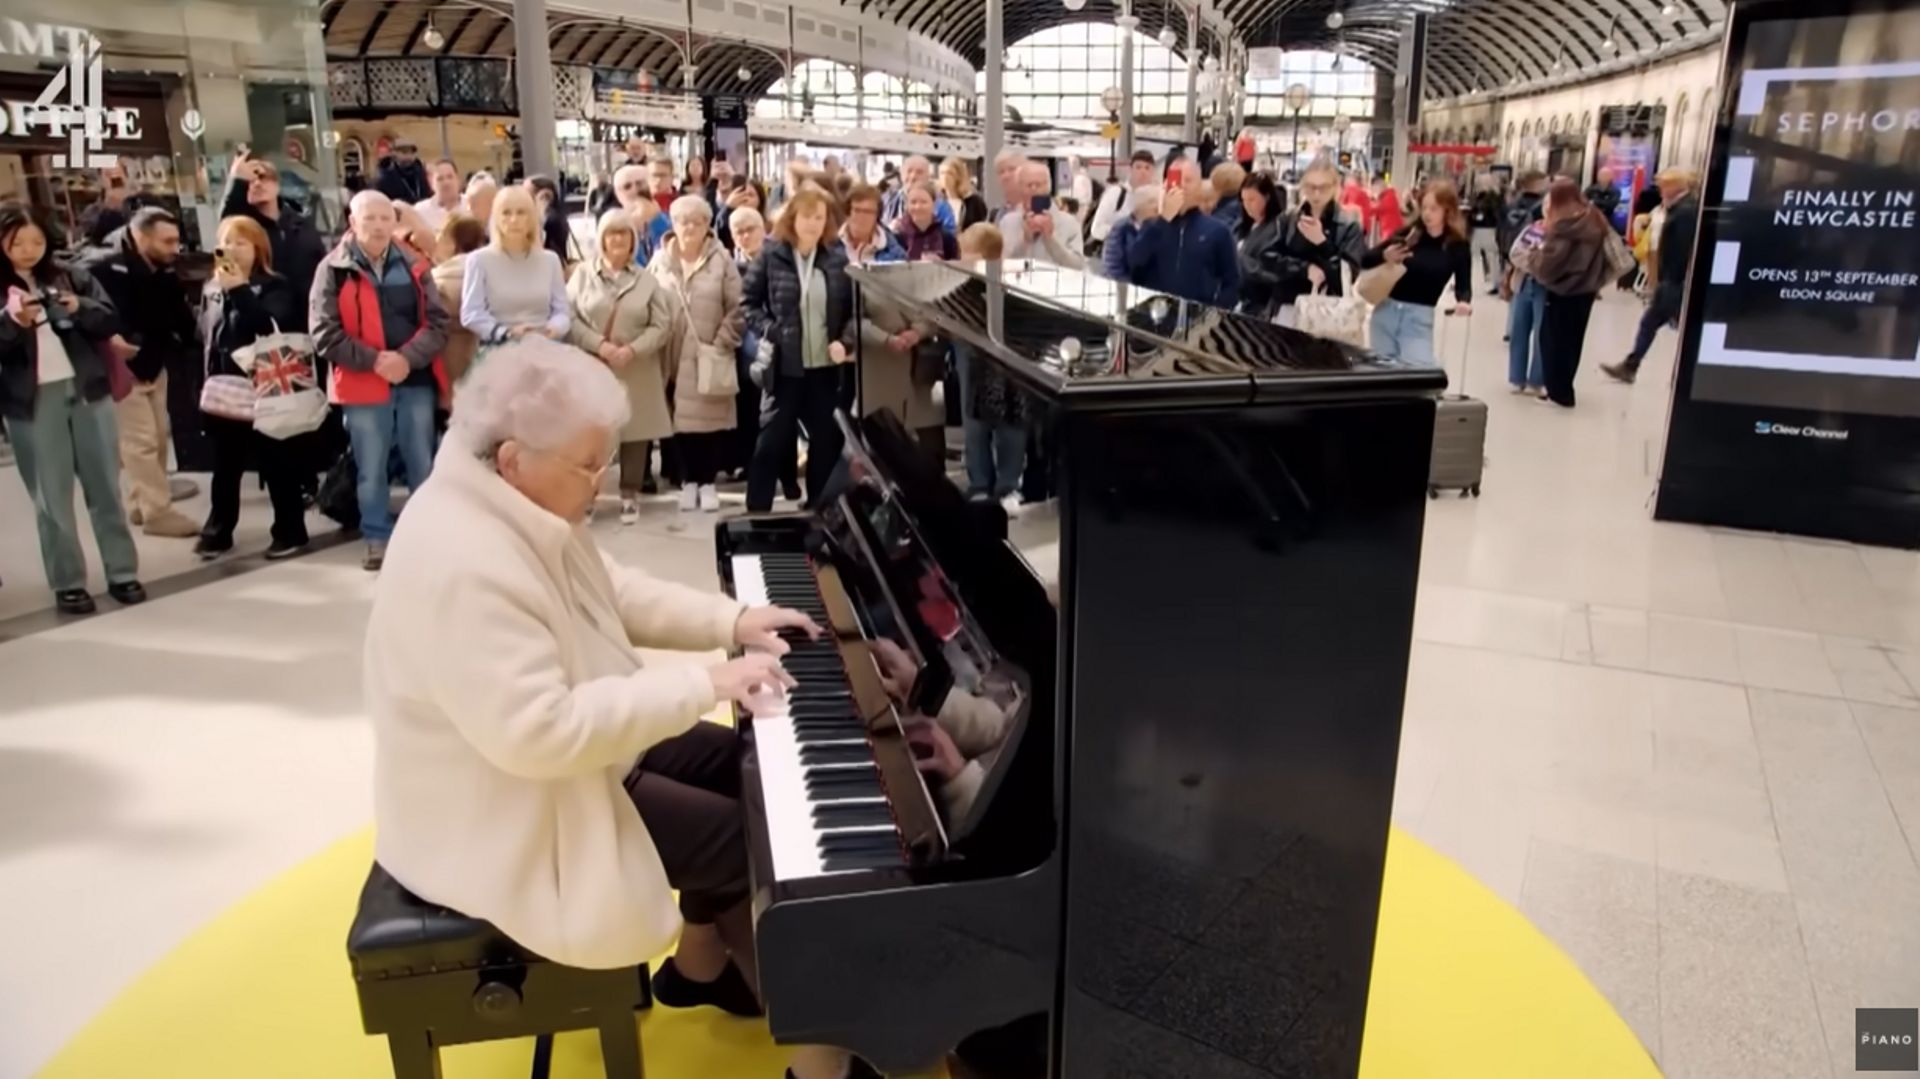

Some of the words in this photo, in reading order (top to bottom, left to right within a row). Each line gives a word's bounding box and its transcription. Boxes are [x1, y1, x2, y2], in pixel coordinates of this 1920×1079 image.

[0, 18, 88, 58] MT
[1783, 190, 1876, 207] FINALLY
[1885, 191, 1914, 207] IN
[1773, 210, 1916, 228] NEWCASTLE
[1749, 268, 1798, 282] OPENS
[1834, 271, 1919, 286] SEPTEMBER
[1780, 288, 1822, 300] ELDON
[1824, 290, 1875, 303] SQUARE
[1802, 426, 1848, 440] Channel
